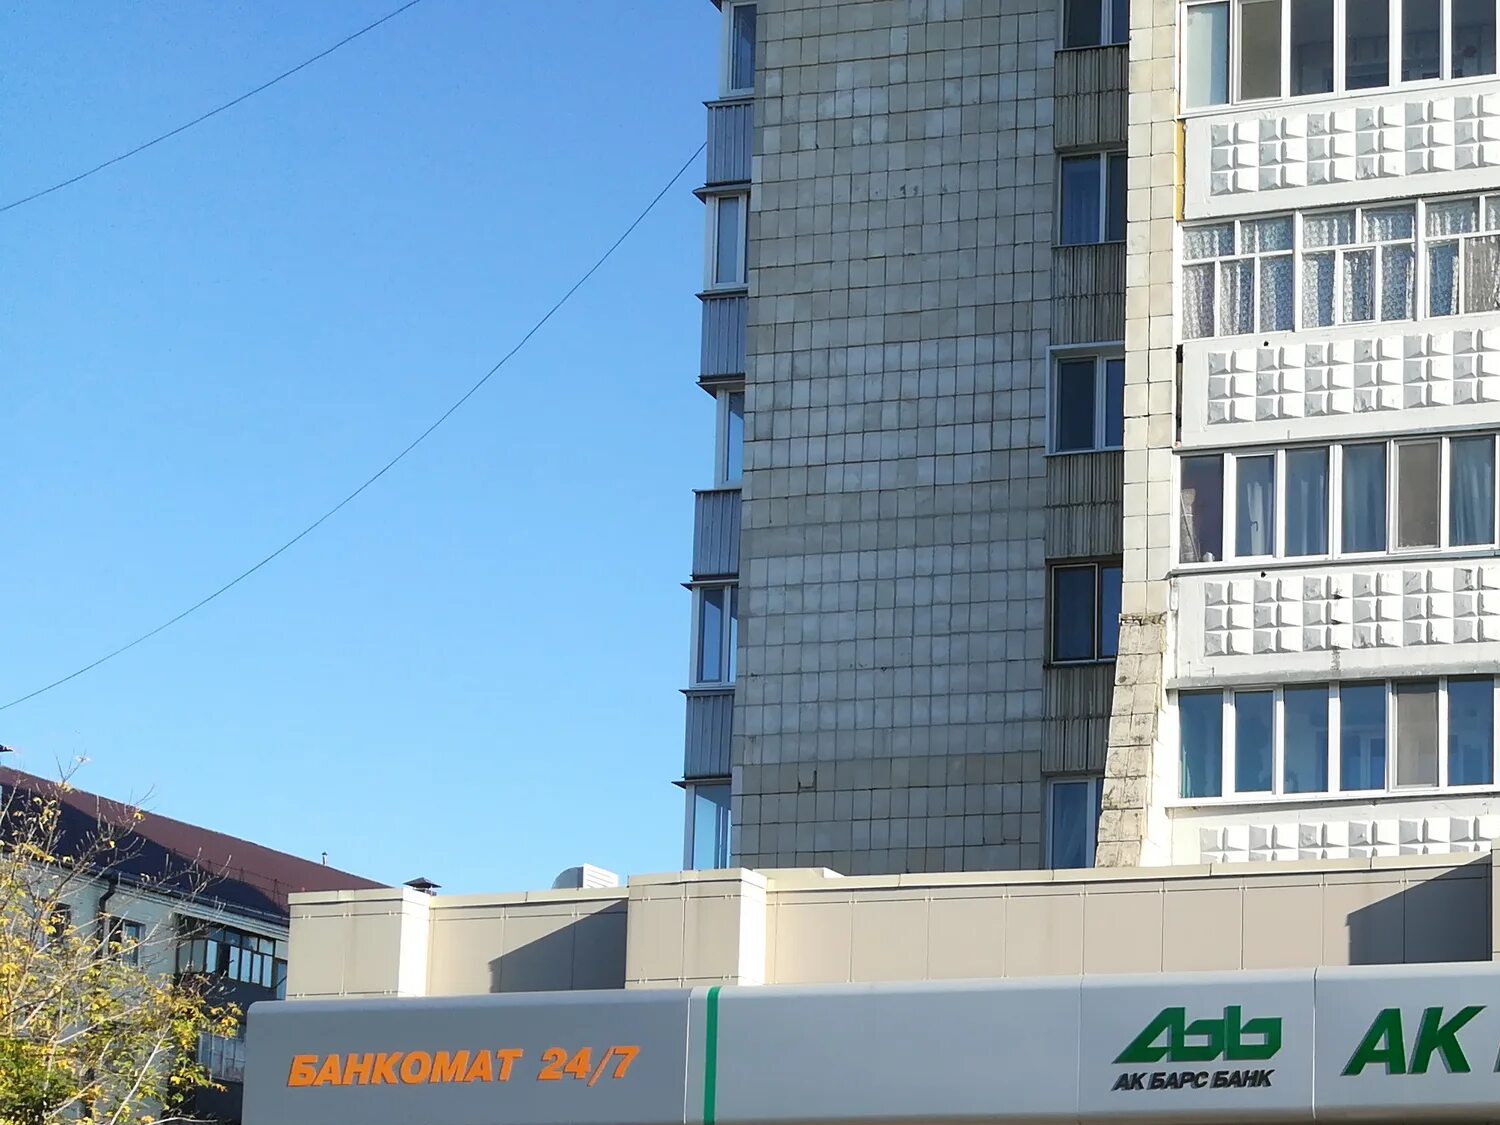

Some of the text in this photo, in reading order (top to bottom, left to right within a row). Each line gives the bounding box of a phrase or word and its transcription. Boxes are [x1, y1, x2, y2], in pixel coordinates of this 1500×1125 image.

[1340, 1005, 1486, 1076] АК
[287, 1045, 640, 1087] БАНКОМАТ 24/7
[1111, 1069, 1275, 1091] АК БАРС БАНК
